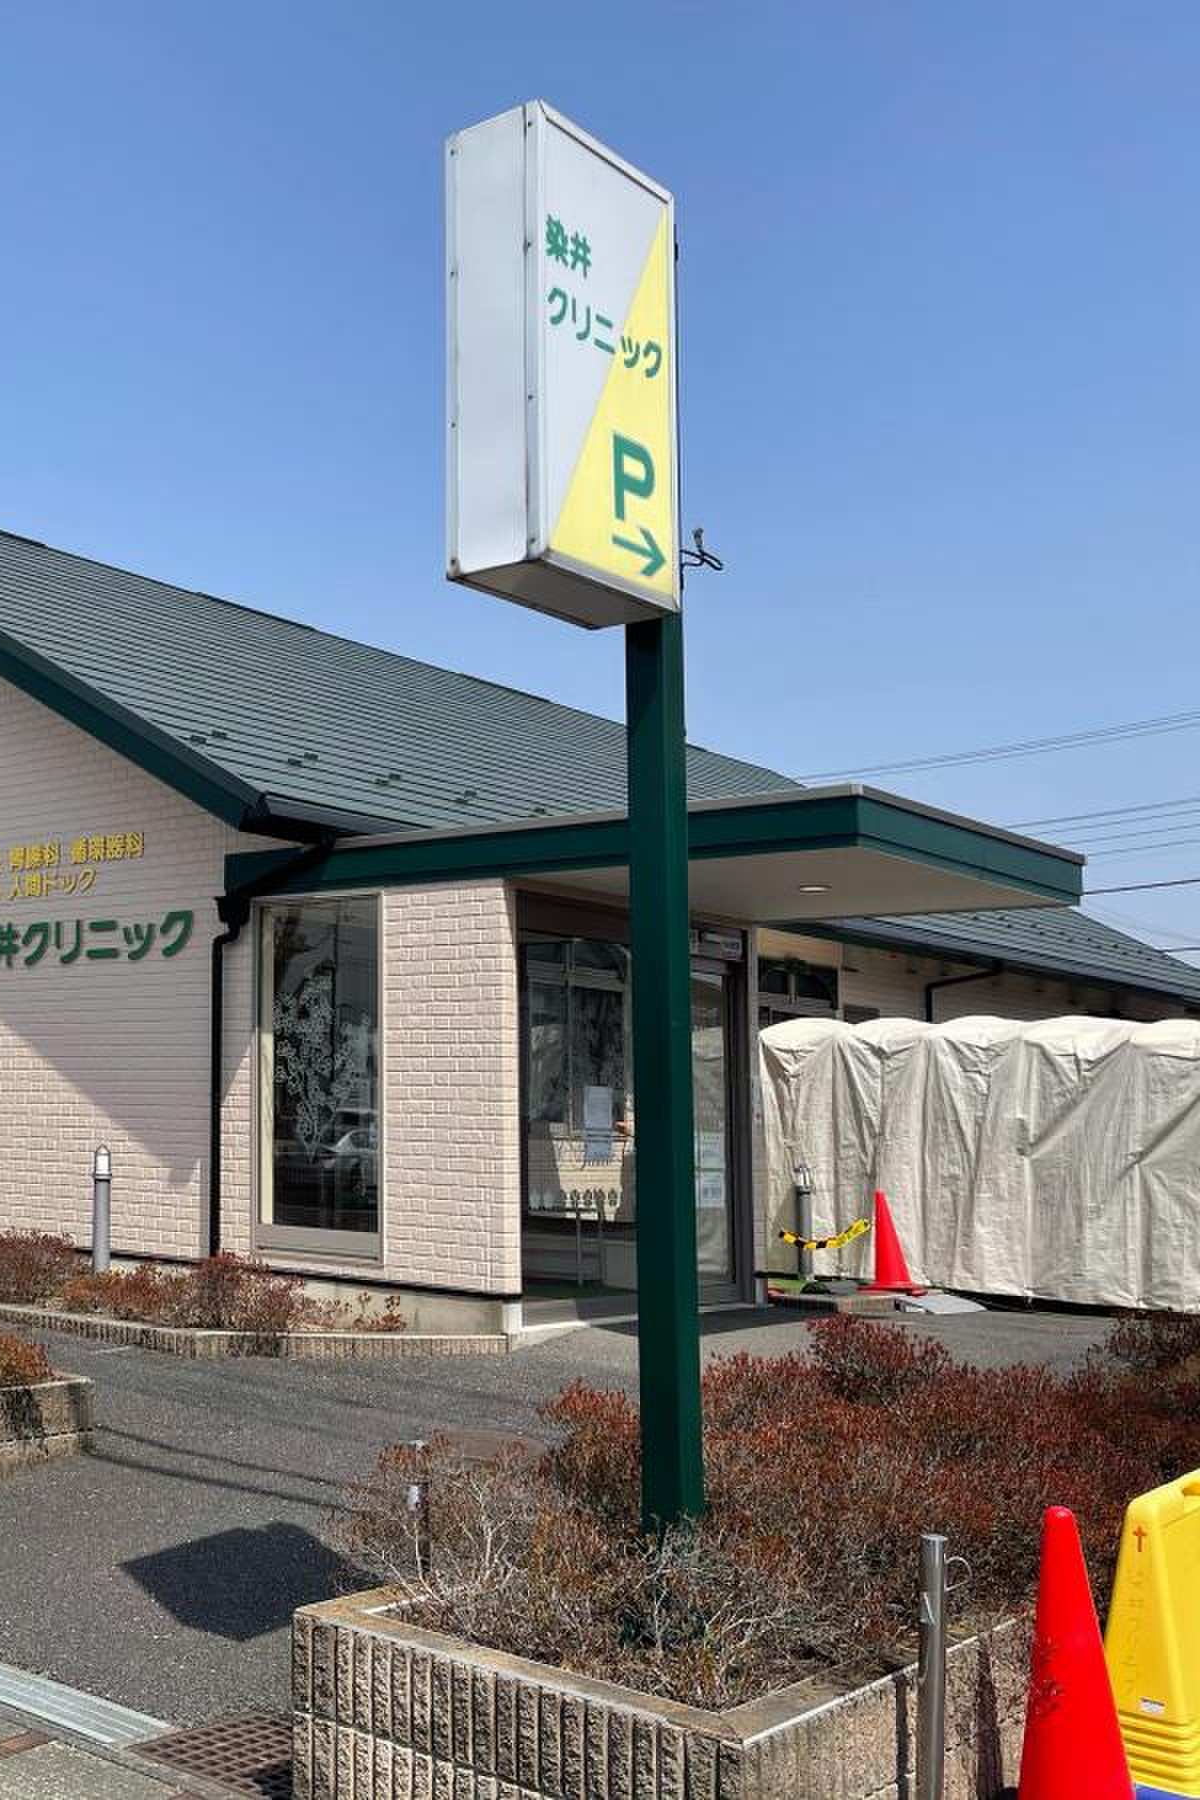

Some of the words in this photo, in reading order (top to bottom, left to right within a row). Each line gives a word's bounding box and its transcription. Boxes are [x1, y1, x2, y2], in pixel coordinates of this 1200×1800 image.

[545, 214, 591, 279] 染井
[548, 287, 662, 378] クリニック
[613, 430, 655, 521] P
[11, 868, 96, 900] 人間ドック
